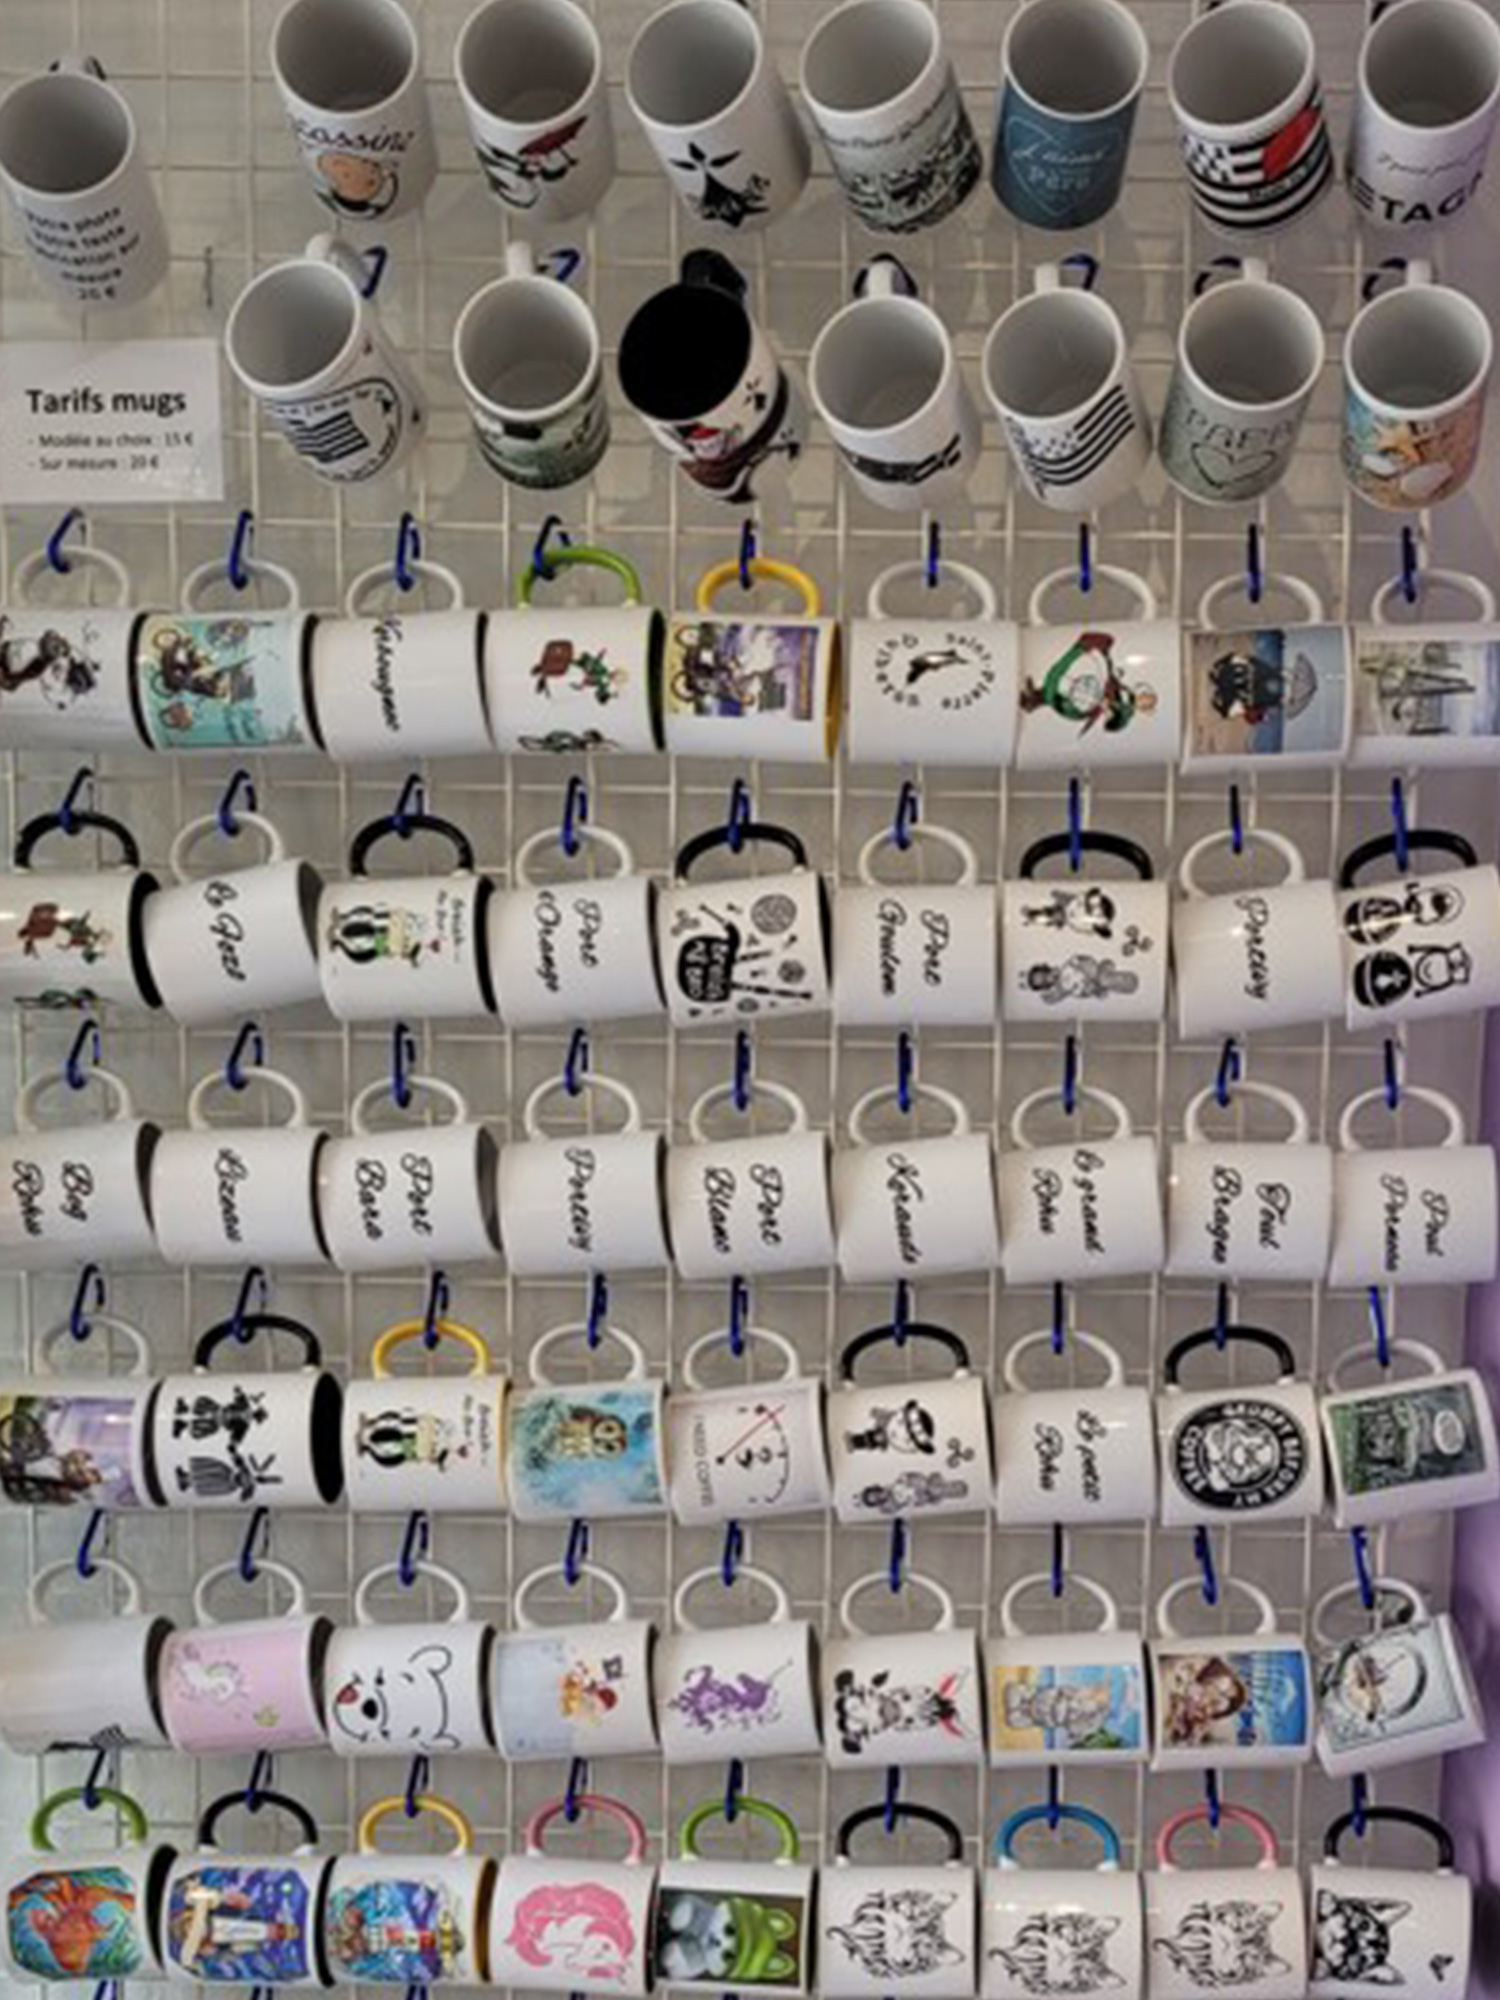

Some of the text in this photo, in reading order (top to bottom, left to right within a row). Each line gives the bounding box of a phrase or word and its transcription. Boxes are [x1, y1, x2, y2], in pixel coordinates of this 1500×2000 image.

[25, 387, 187, 418] Tarifs mugs
[39, 455, 160, 470] Sur mesure 20 €
[96, 436, 113, 447] au
[164, 433, 182, 447] 15
[184, 432, 194, 447] €
[573, 899, 601, 968] Port
[919, 910, 950, 988] Port
[400, 1153, 434, 1236] Port
[748, 1163, 784, 1245] Port
